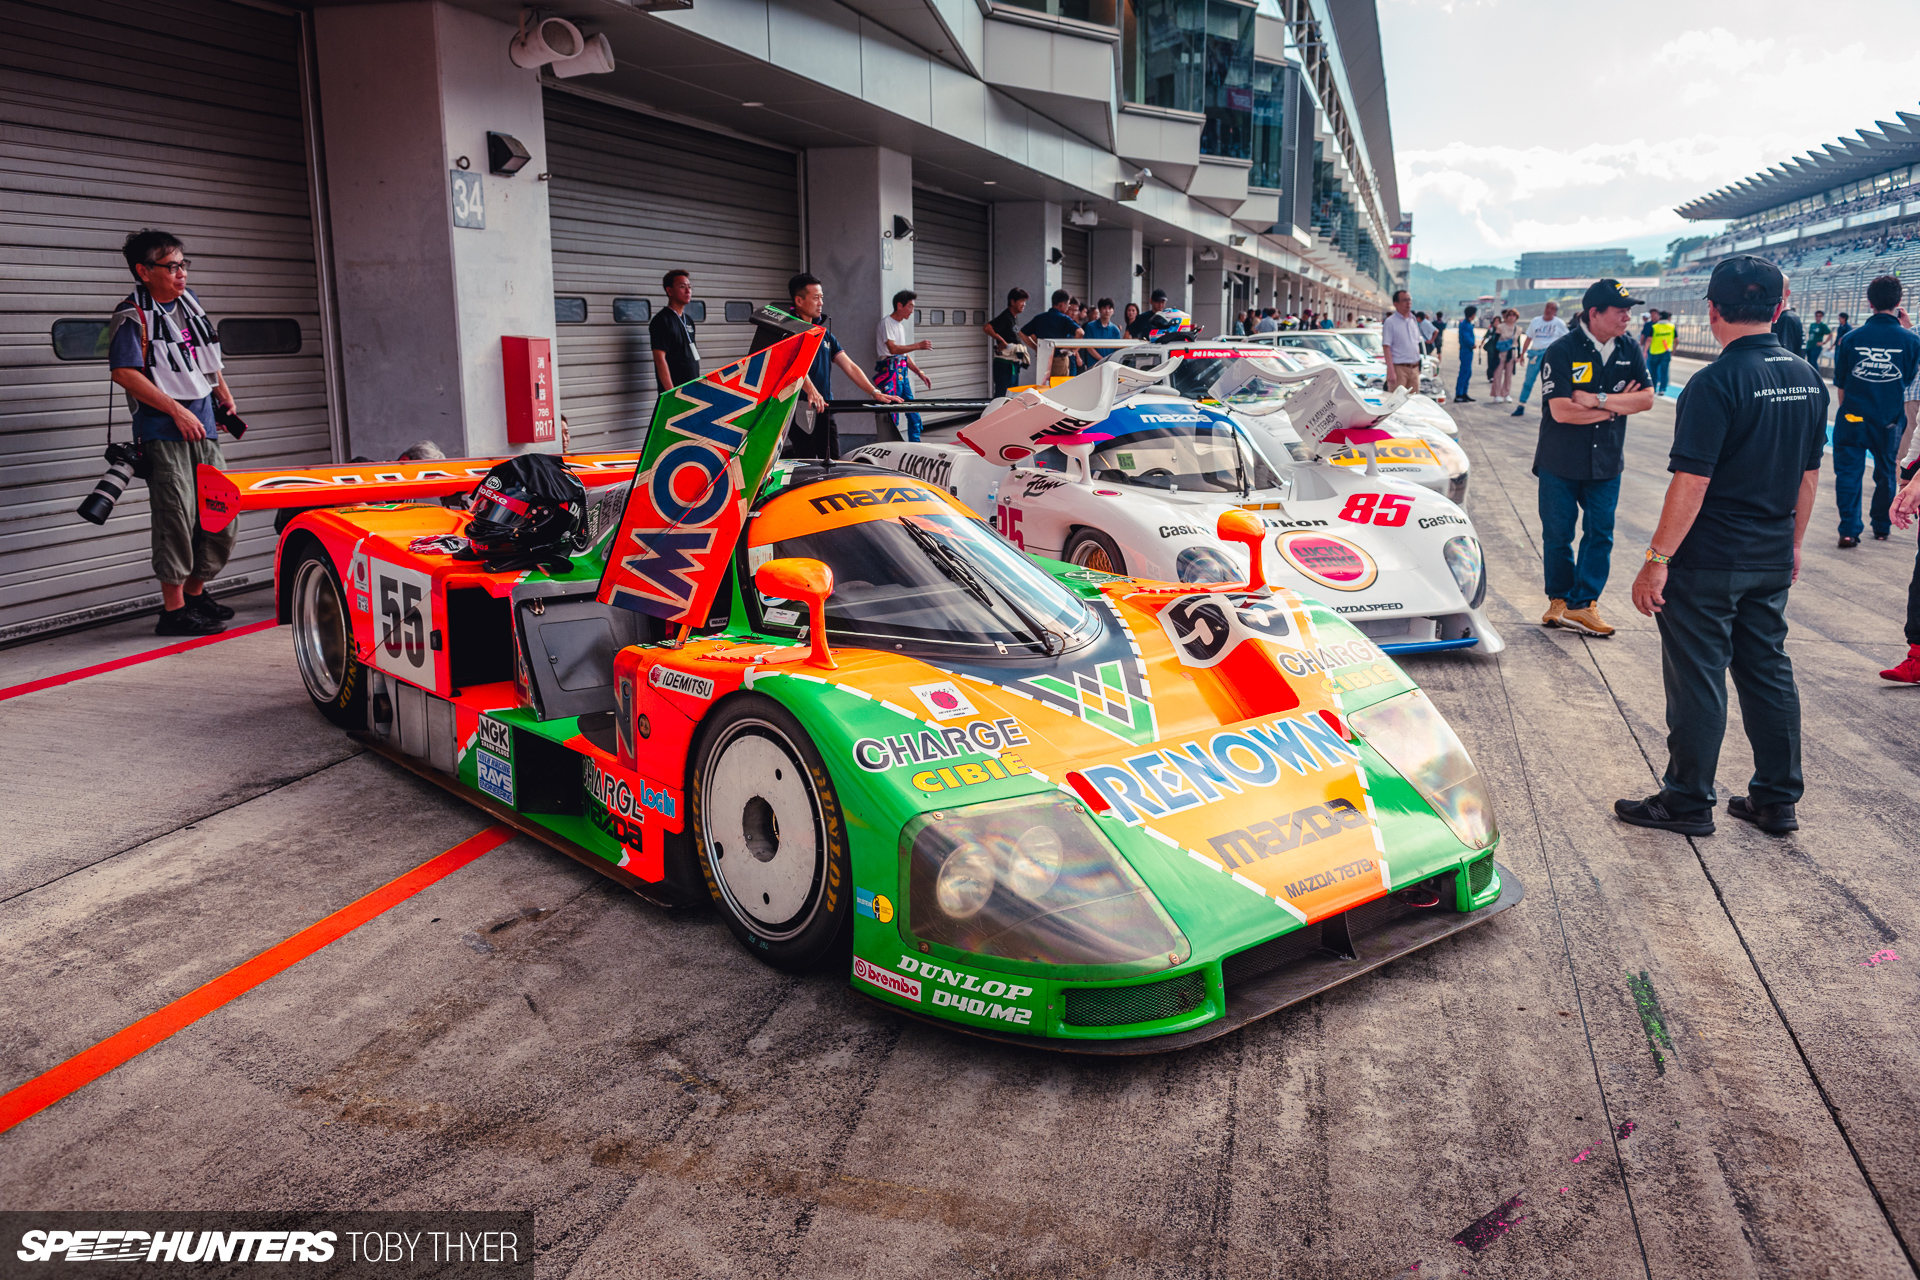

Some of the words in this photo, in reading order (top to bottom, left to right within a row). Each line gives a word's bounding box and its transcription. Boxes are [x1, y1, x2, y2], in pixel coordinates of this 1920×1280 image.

[454, 179, 483, 220] 34
[883, 243, 893, 266] 33
[537, 357, 546, 401] 消火器
[1753, 388, 1776, 398] MAZDA
[1788, 386, 1807, 394] FESTA
[1807, 386, 1820, 394] 2023
[535, 420, 552, 436] PR17
[1139, 413, 1213, 423] mazda
[1307, 400, 1336, 427] Y.KATAYAMA
[1314, 412, 1338, 434] Y.TERADA
[808, 487, 947, 516] mazda
[1338, 493, 1416, 527] 85
[1293, 545, 1346, 559] LUCKY
[1302, 554, 1361, 570] STRIKE
[380, 574, 425, 668] 55
[1168, 592, 1290, 660] 55
[662, 671, 713, 698] IDEMITSU
[480, 718, 508, 749] NGK
[853, 716, 1031, 773] CHARGE
[495, 747, 510, 758] PLUGS
[479, 763, 513, 793] RAYS
[912, 752, 1032, 793] CIBIÉ
[1080, 710, 1362, 827] RENOWN
[811, 766, 841, 913] DUNLOP
[1206, 797, 1370, 870] mazda
[1284, 871, 1336, 899] MAZDA
[1336, 858, 1373, 883] 787B
[857, 896, 873, 908] BILSTEIN
[868, 965, 919, 997] brembo
[897, 955, 1033, 1000] DUNLOP
[932, 989, 1032, 1025] D40/M2
